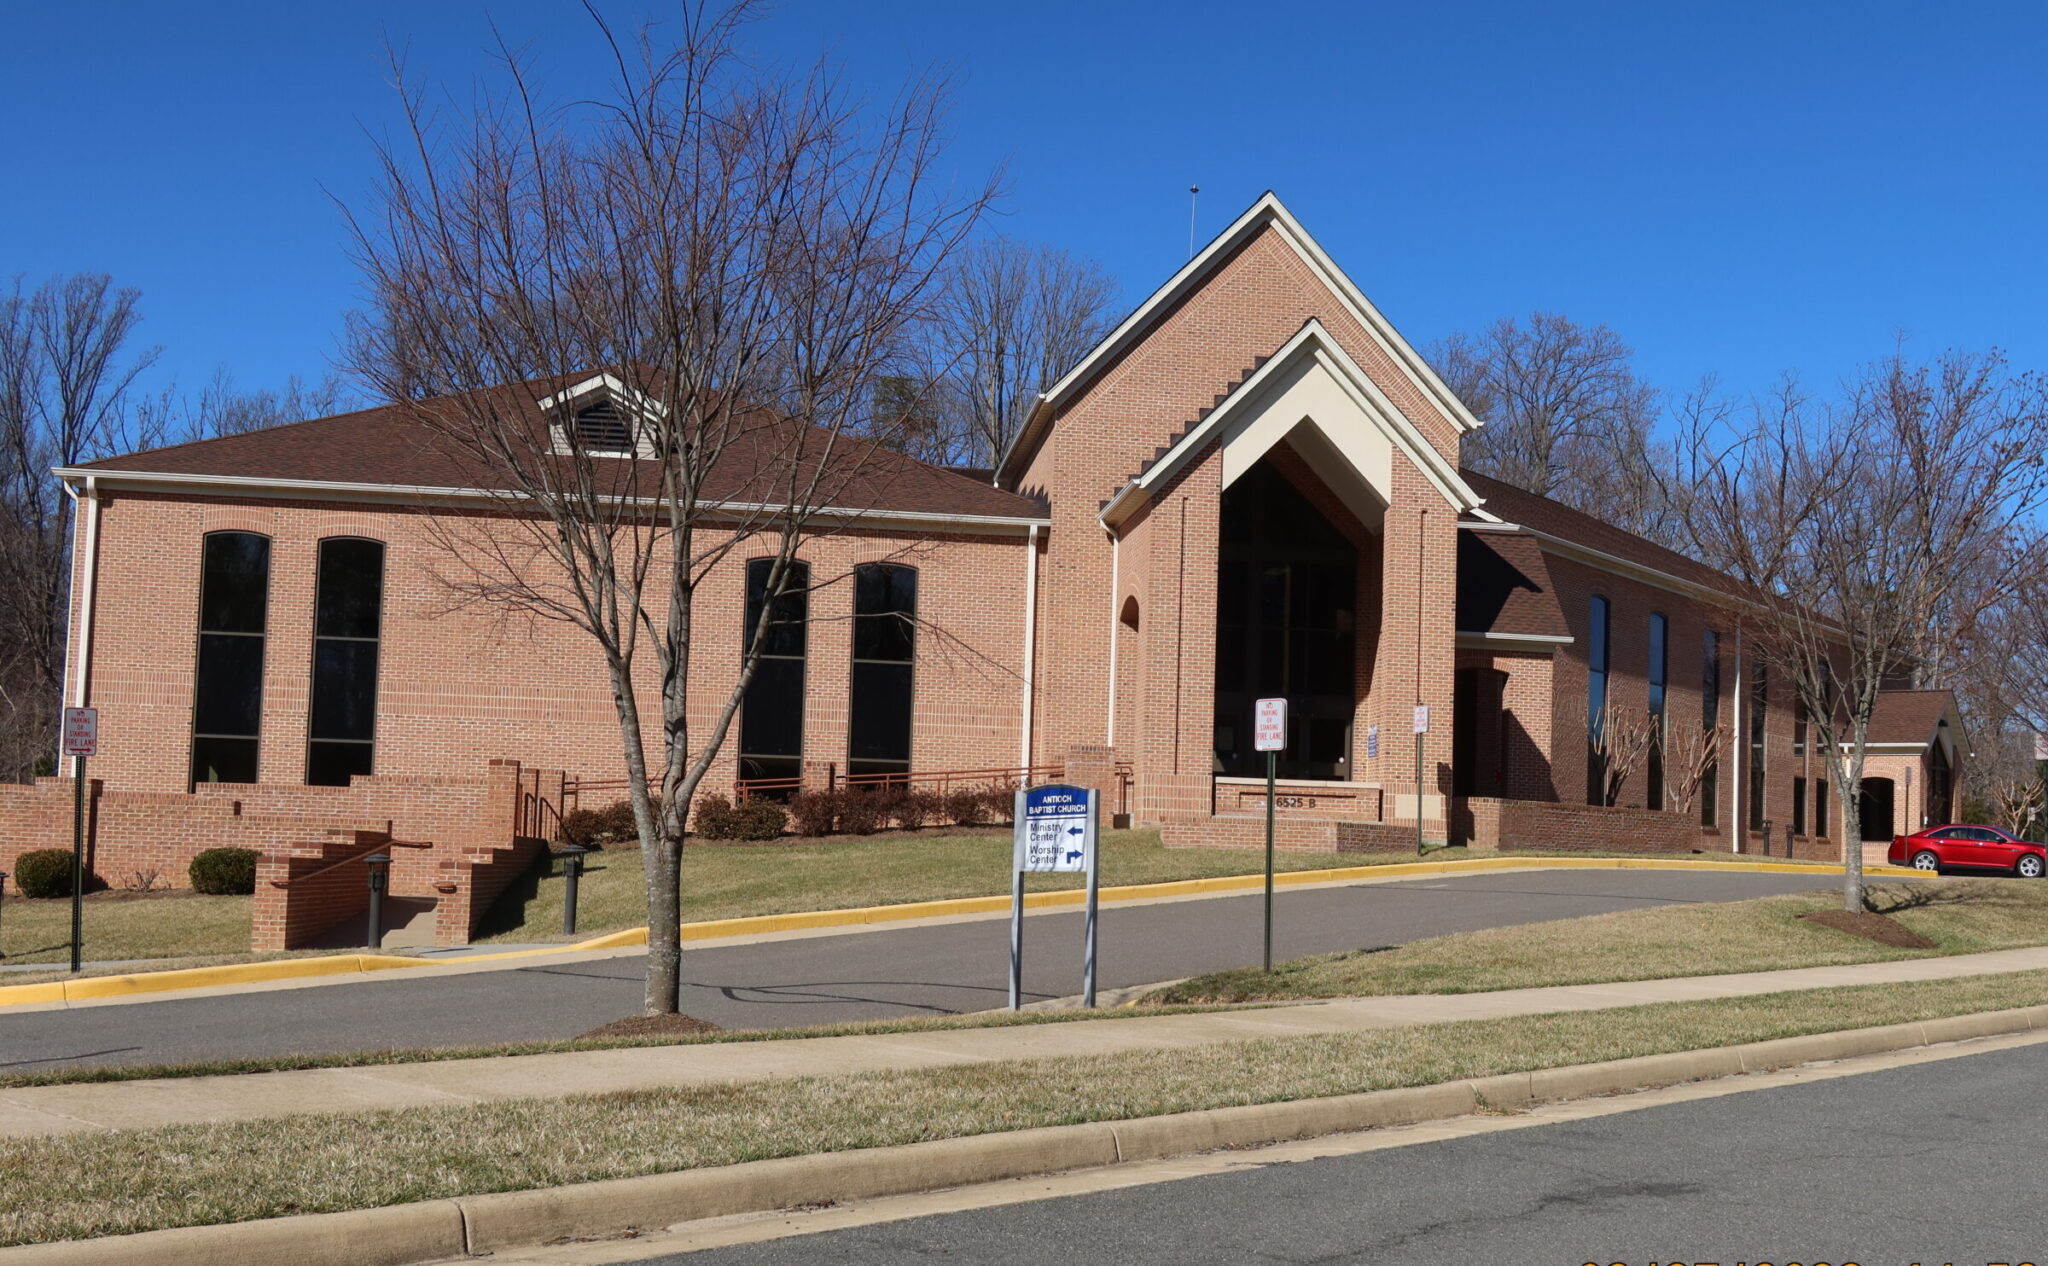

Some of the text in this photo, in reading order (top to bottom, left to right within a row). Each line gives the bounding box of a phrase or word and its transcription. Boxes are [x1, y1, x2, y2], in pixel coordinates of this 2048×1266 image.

[1042, 794, 1072, 804] ANTIOCH
[1276, 797, 1317, 808] 6525 B
[1028, 804, 1086, 815] BAPTIST CHURCH
[1030, 823, 1063, 833] Ministry
[1030, 833, 1058, 842] Center
[1030, 845, 1065, 854] Worship
[1030, 855, 1058, 864] Center
